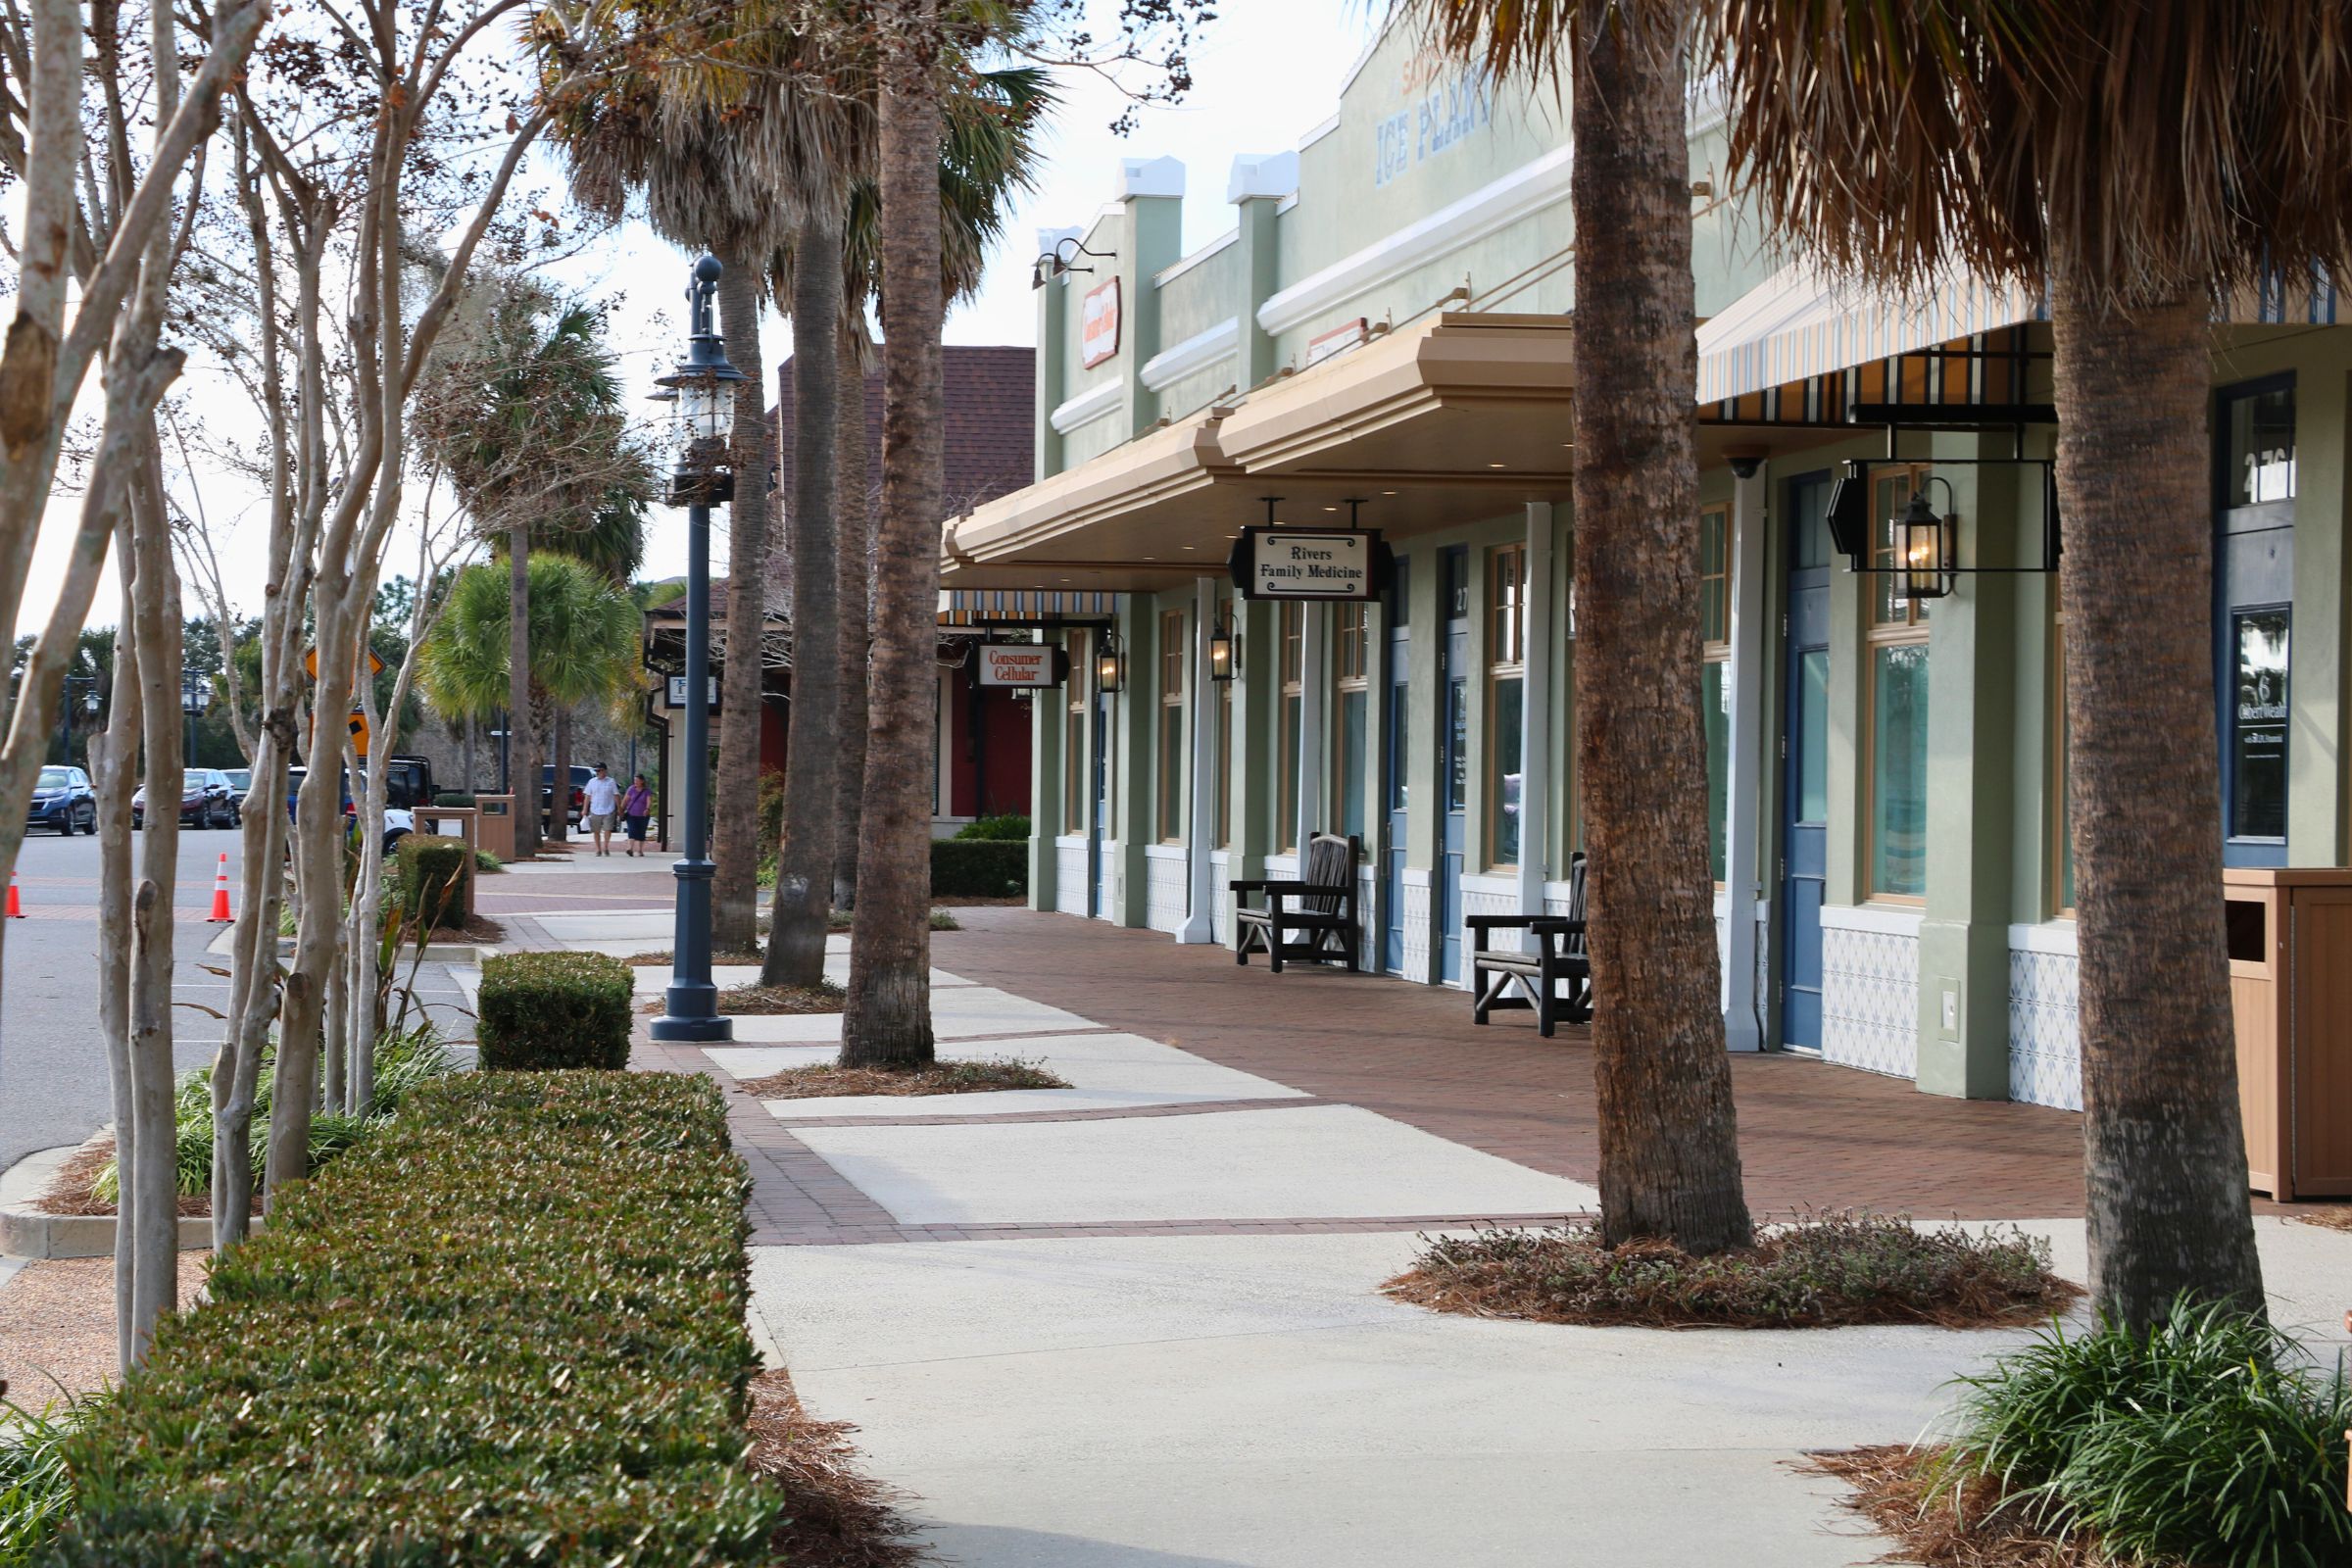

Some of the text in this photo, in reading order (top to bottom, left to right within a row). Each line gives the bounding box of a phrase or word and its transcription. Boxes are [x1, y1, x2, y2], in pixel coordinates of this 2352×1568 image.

[1376, 112, 1409, 187] ICE
[1291, 546, 1333, 561] Rivers
[1260, 564, 1363, 580] Family Medicine
[989, 650, 1044, 665] Consumer
[995, 665, 1040, 681] Cellular
